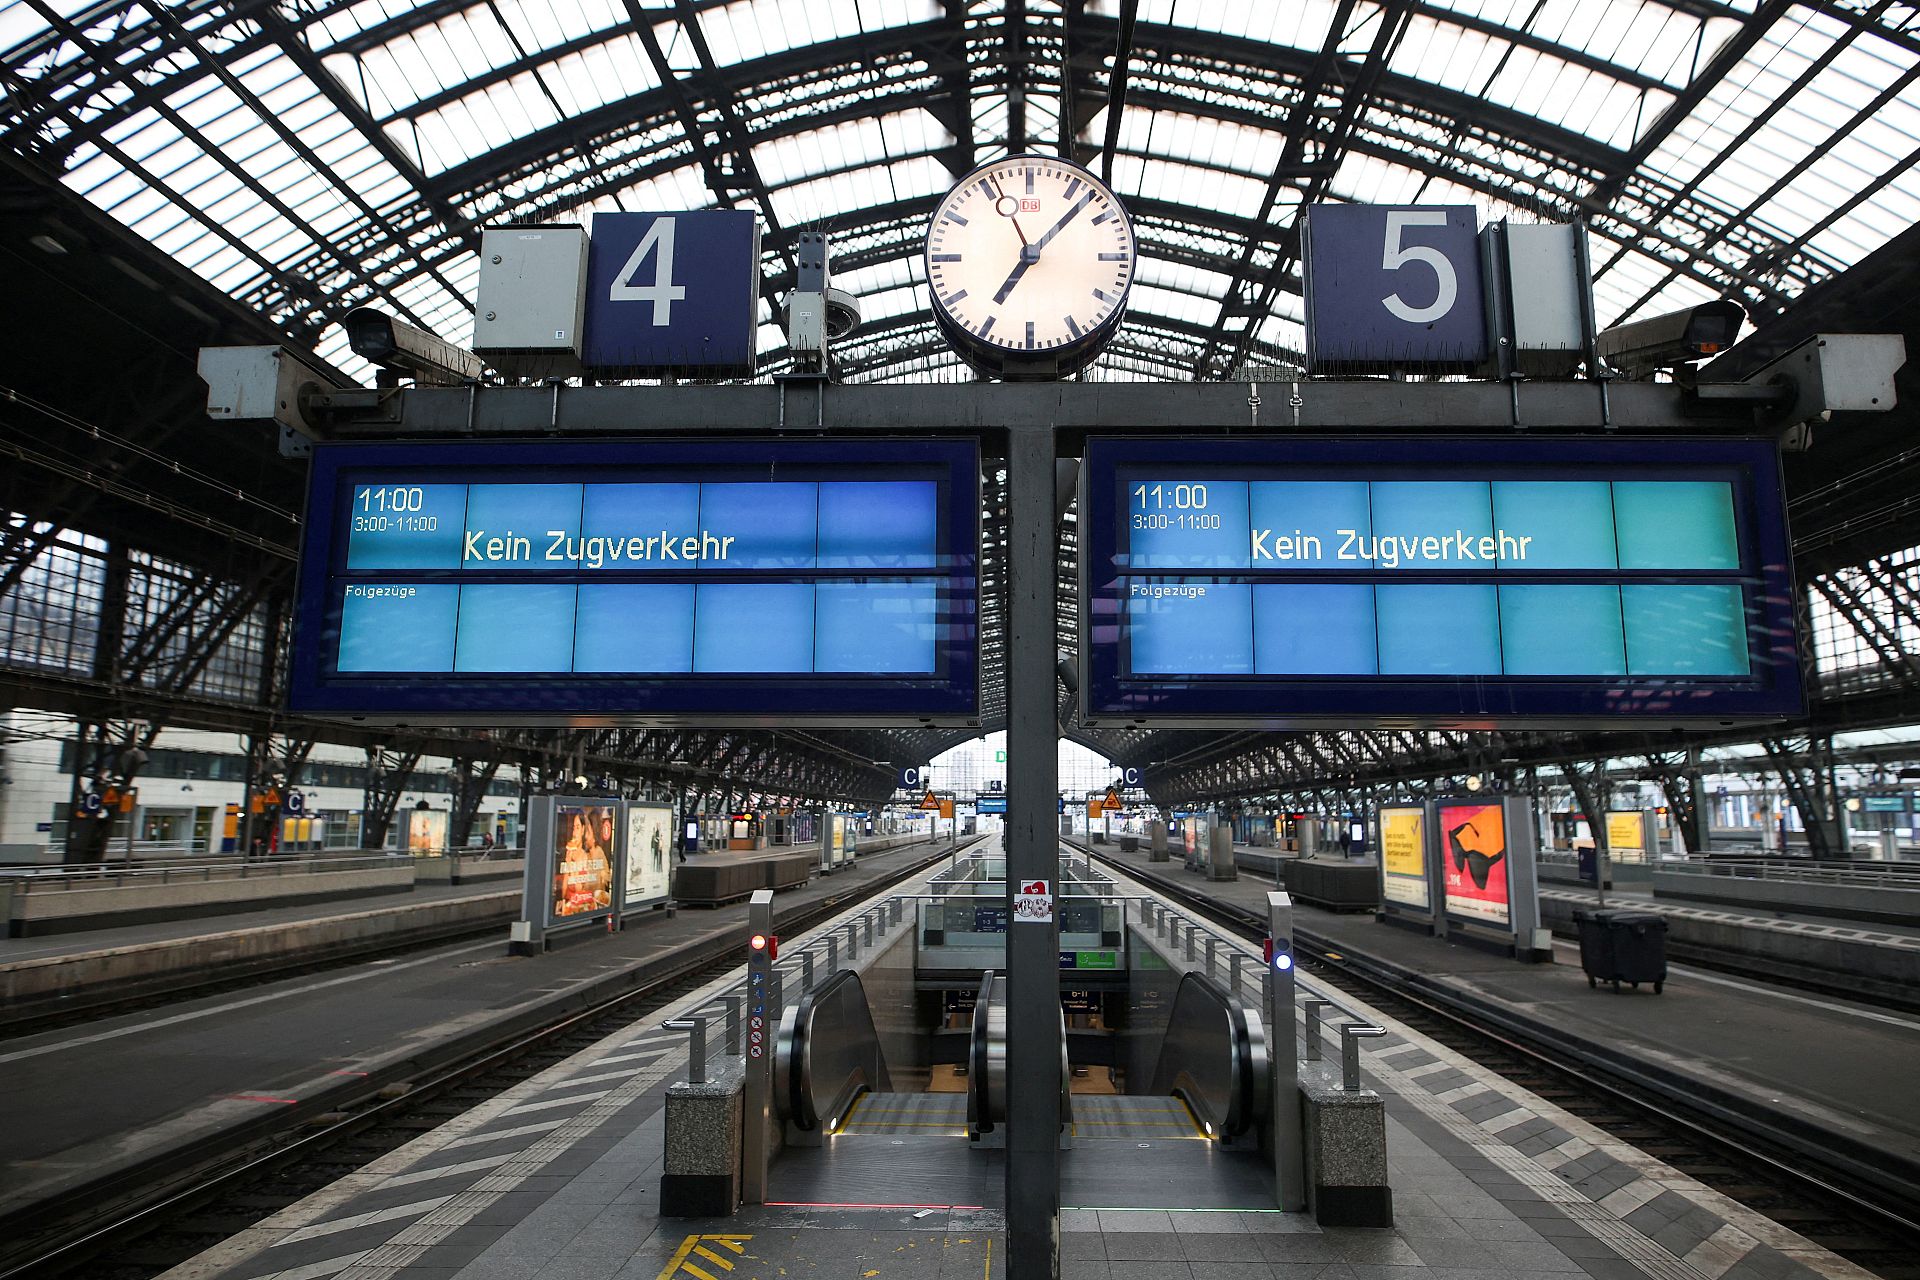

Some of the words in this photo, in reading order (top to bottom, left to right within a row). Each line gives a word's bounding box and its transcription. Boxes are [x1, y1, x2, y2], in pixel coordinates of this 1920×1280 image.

[1021, 201, 1039, 211] DB
[610, 217, 686, 326] 4
[1382, 211, 1458, 323] 5
[359, 487, 423, 512] 11:00
[1134, 484, 1207, 509] 11:00
[354, 516, 437, 532] 3:00-11:00
[1133, 514, 1221, 530] 3:00-11:00
[464, 530, 531, 561] Kein
[545, 530, 735, 569] Zugverkehr
[1252, 529, 1322, 560] Kein
[1336, 529, 1533, 569] Zugverkehr
[345, 585, 416, 599] Folgezüge
[1130, 584, 1206, 599] Folgezüge
[995, 751, 1006, 762] D
[602, 779, 609, 788] 3
[904, 768, 917, 785] C
[1125, 767, 1138, 784] C
[991, 781, 998, 789] 4
[86, 793, 100, 810] C
[288, 794, 301, 811] C
